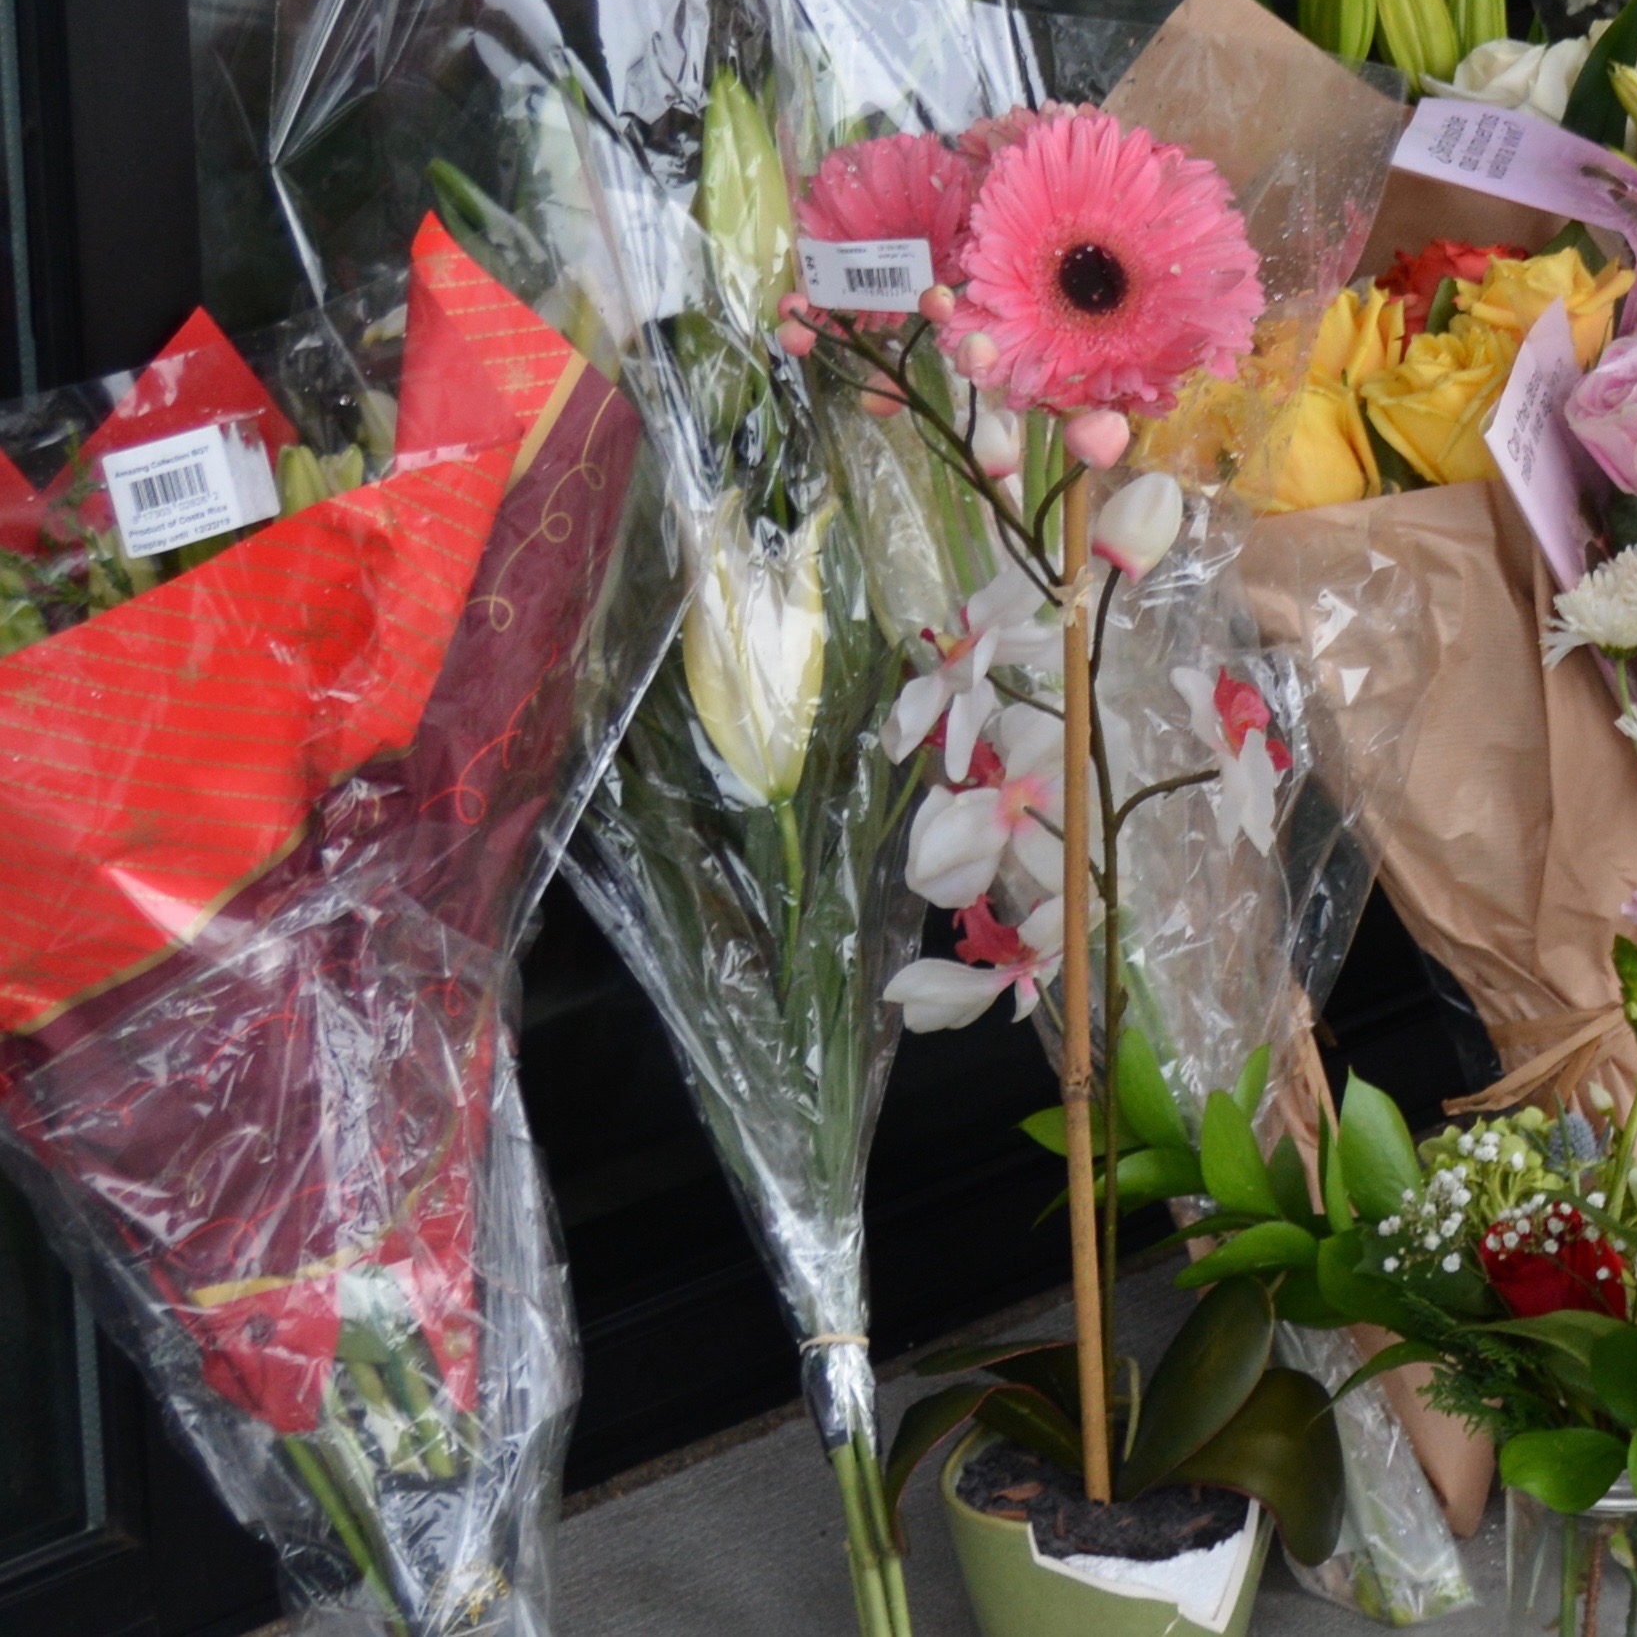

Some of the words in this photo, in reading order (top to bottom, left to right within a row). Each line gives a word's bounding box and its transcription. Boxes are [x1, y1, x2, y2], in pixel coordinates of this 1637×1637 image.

[129, 524, 165, 538] Product
[167, 519, 176, 528] of
[179, 512, 204, 525] Costa
[207, 505, 227, 514] Rica
